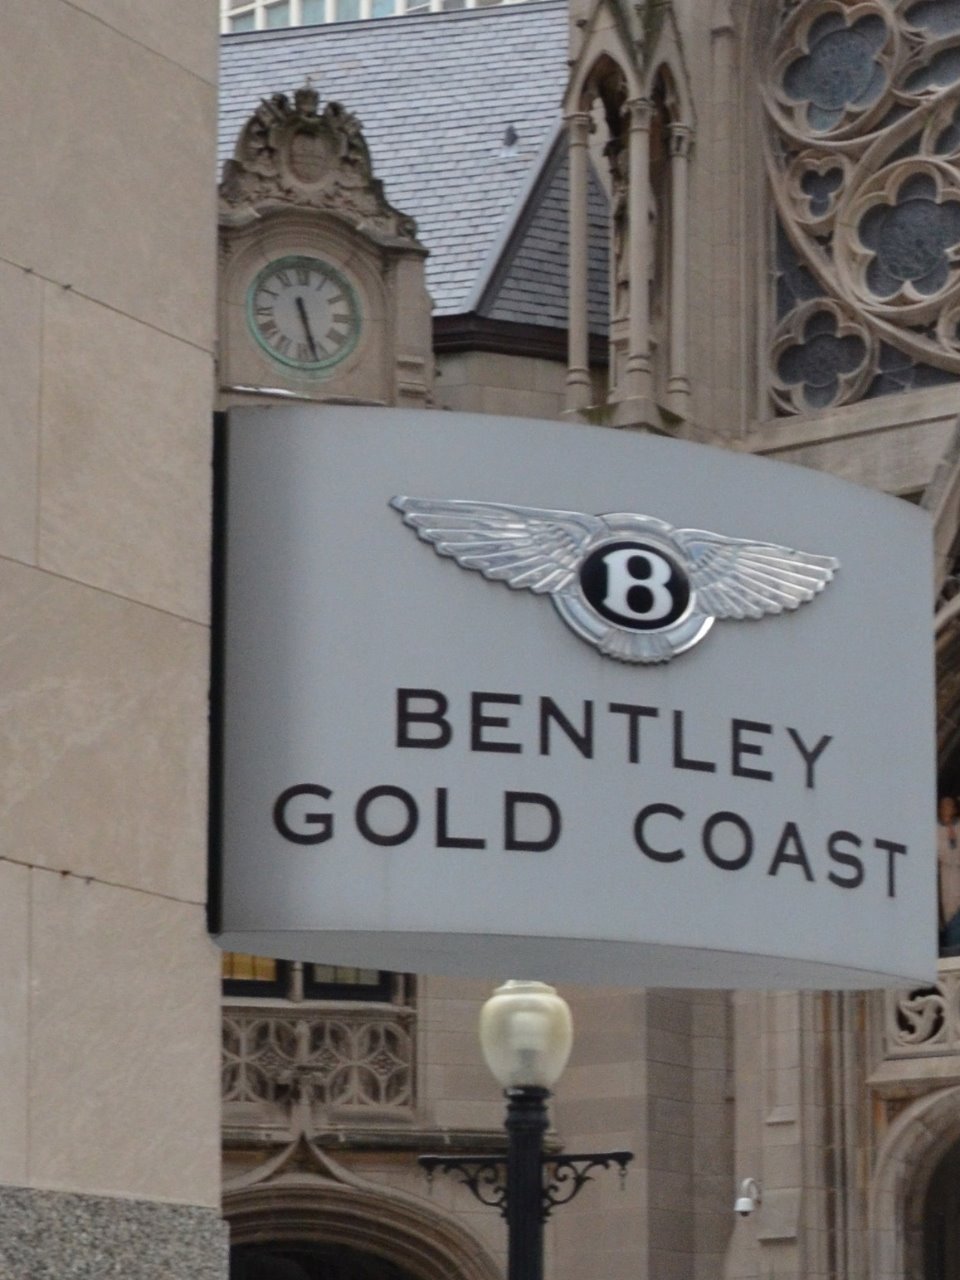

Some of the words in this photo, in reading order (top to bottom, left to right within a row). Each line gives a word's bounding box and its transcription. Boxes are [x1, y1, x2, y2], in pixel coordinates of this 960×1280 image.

[603, 546, 674, 620] B
[395, 688, 834, 790] BENTLEY
[272, 783, 562, 853] GOLD
[633, 803, 908, 898] COAST
